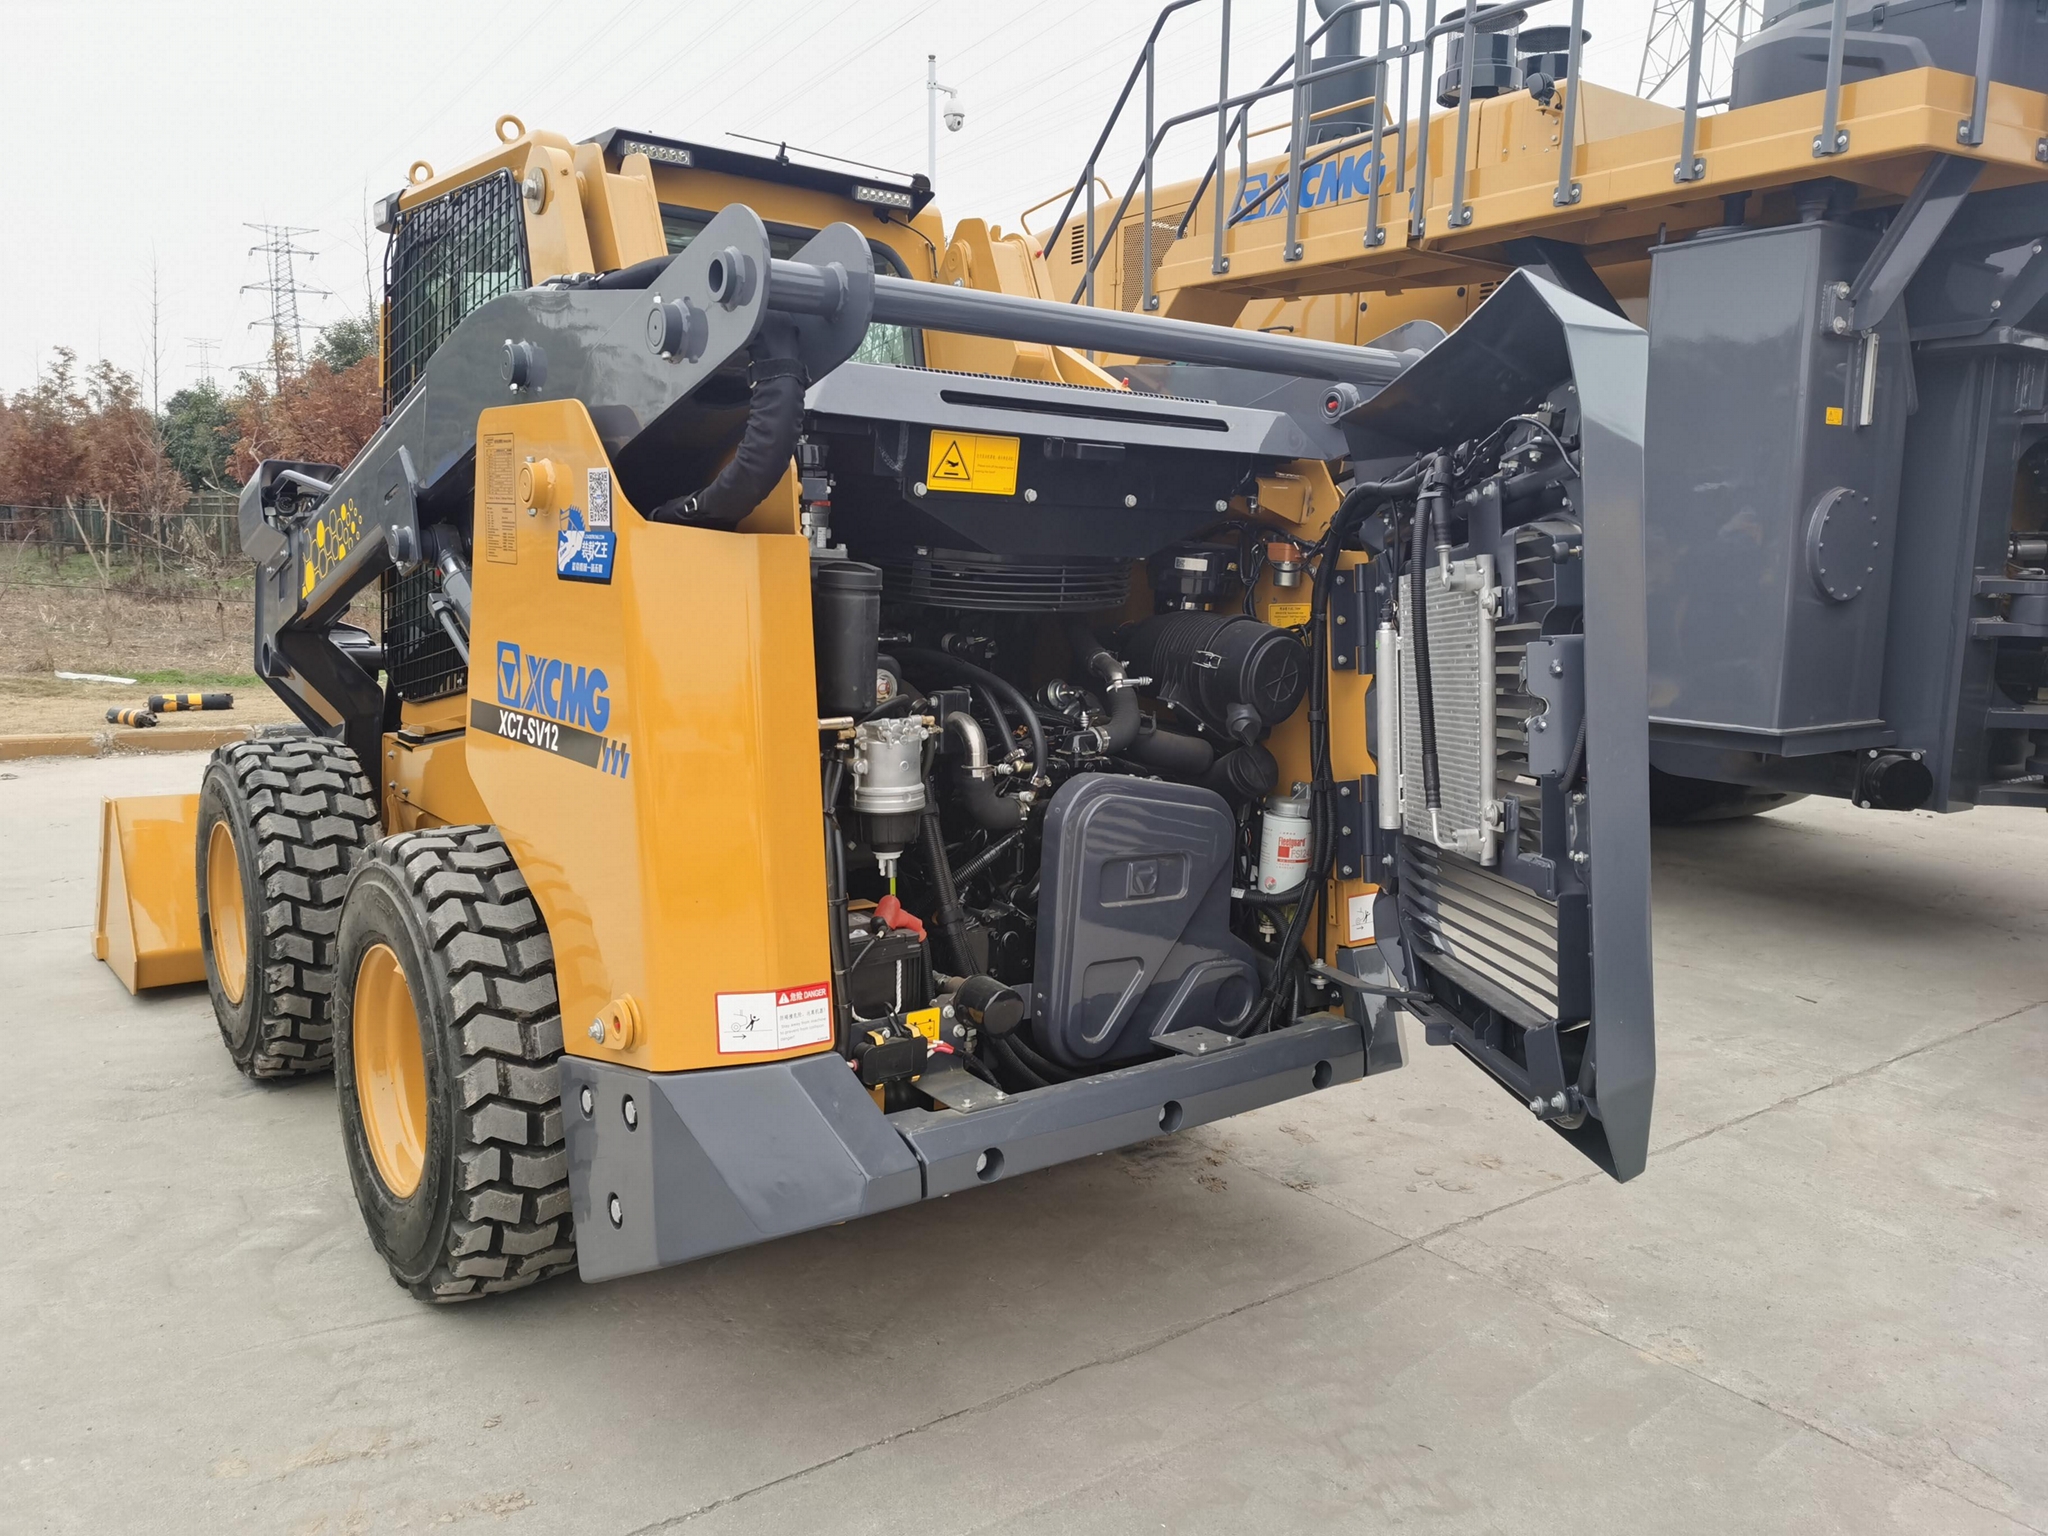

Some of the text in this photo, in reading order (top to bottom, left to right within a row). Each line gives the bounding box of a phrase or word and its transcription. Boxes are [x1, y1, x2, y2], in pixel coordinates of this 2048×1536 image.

[1267, 149, 1387, 215] XCMG
[521, 653, 610, 733] XCMG
[498, 709, 559, 751] XC7-SV12
[1278, 836, 1307, 848] Fleetguard
[804, 988, 826, 998] DANGER
